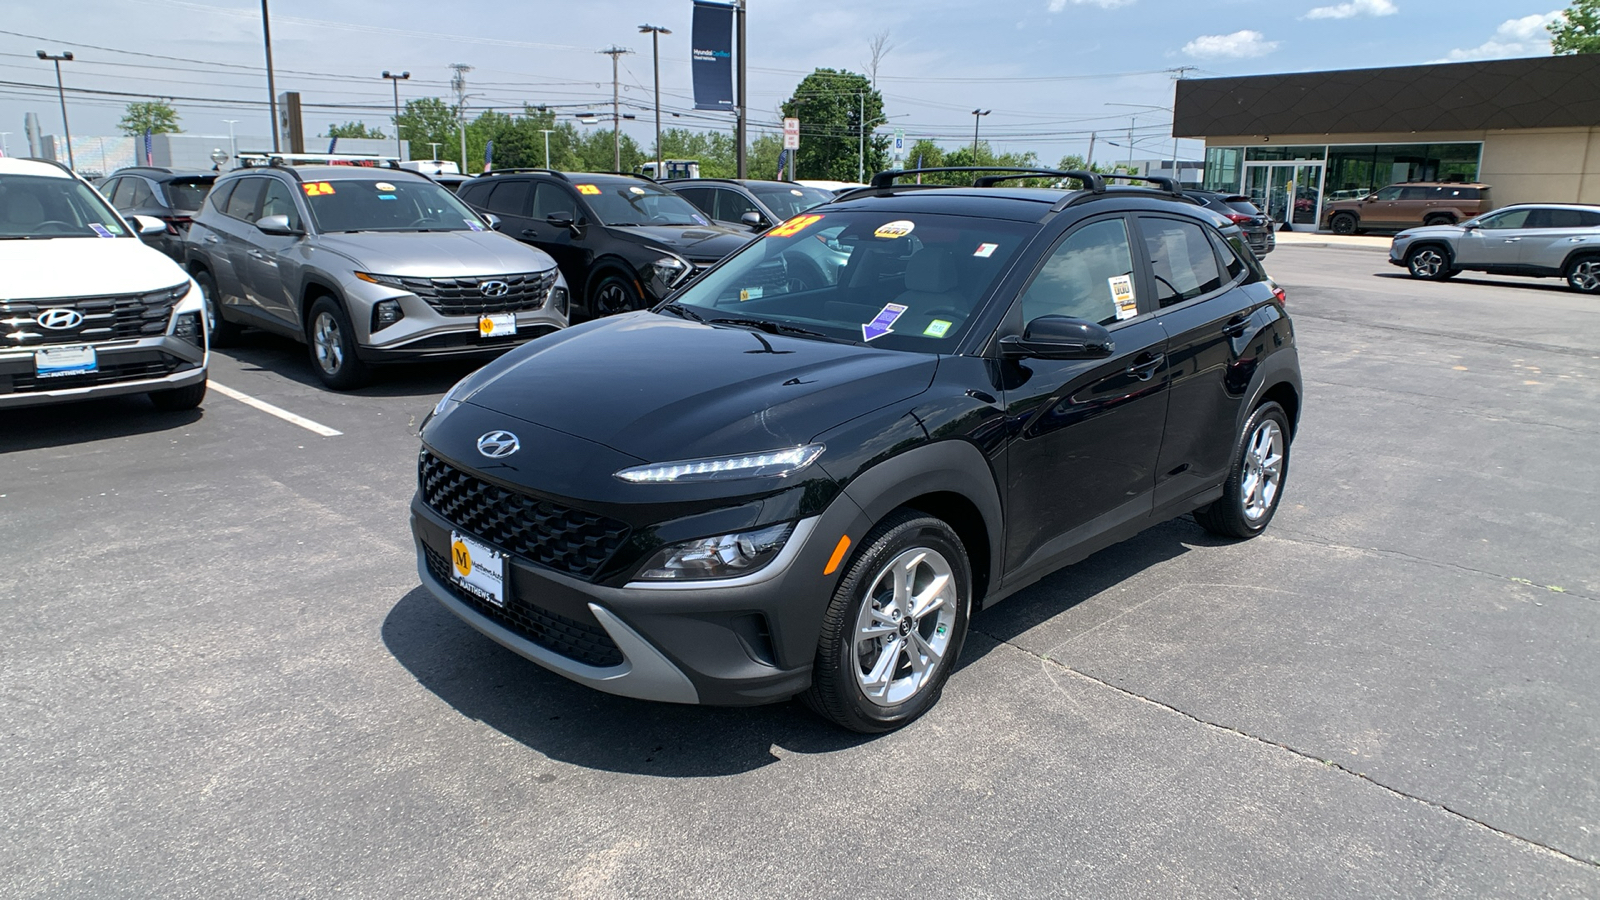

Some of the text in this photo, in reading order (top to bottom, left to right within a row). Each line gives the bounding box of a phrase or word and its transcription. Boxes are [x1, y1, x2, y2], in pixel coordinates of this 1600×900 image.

[304, 182, 334, 196] 24
[577, 184, 601, 195] 23
[483, 322, 491, 330] M
[454, 547, 469, 570] M
[459, 579, 491, 602] MATTHEWS
